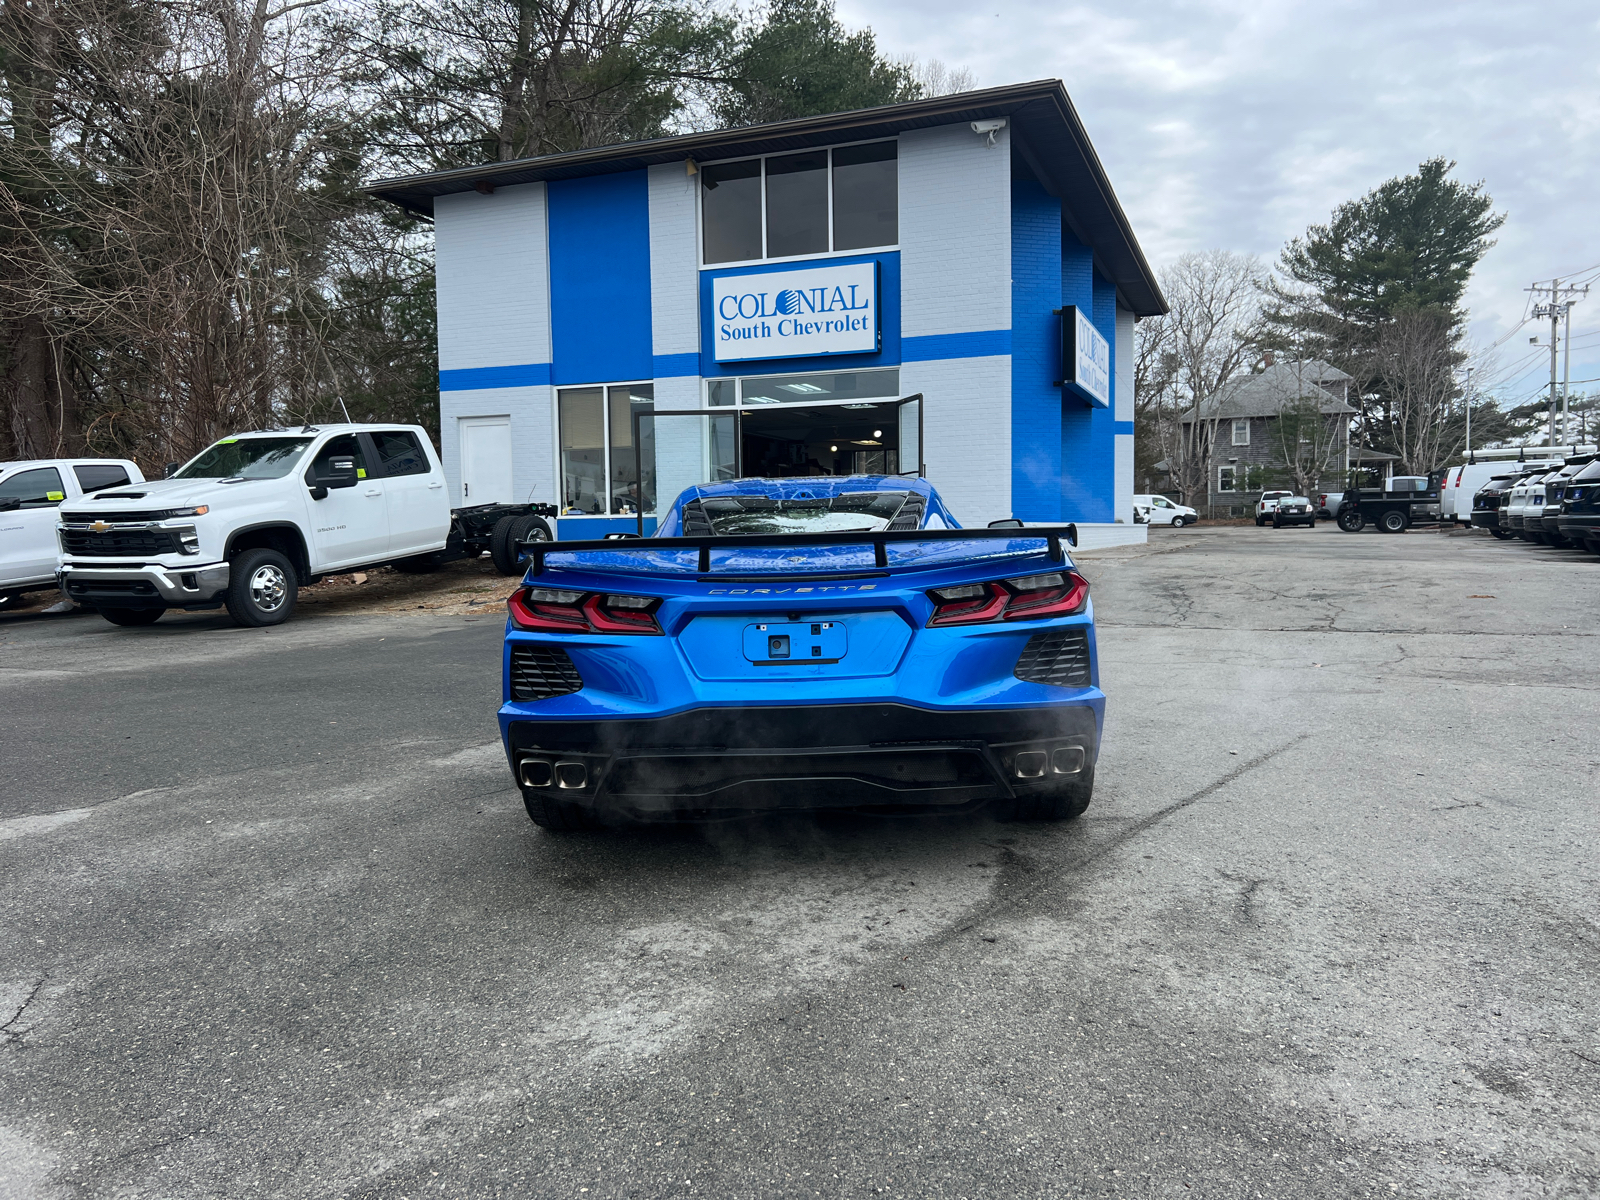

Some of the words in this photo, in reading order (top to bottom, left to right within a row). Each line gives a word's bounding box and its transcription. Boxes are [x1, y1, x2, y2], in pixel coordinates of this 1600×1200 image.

[719, 284, 869, 321] COLONIAL
[721, 321, 772, 341] South
[777, 314, 869, 337] Chevrolet
[708, 584, 877, 595] CORVETTE
